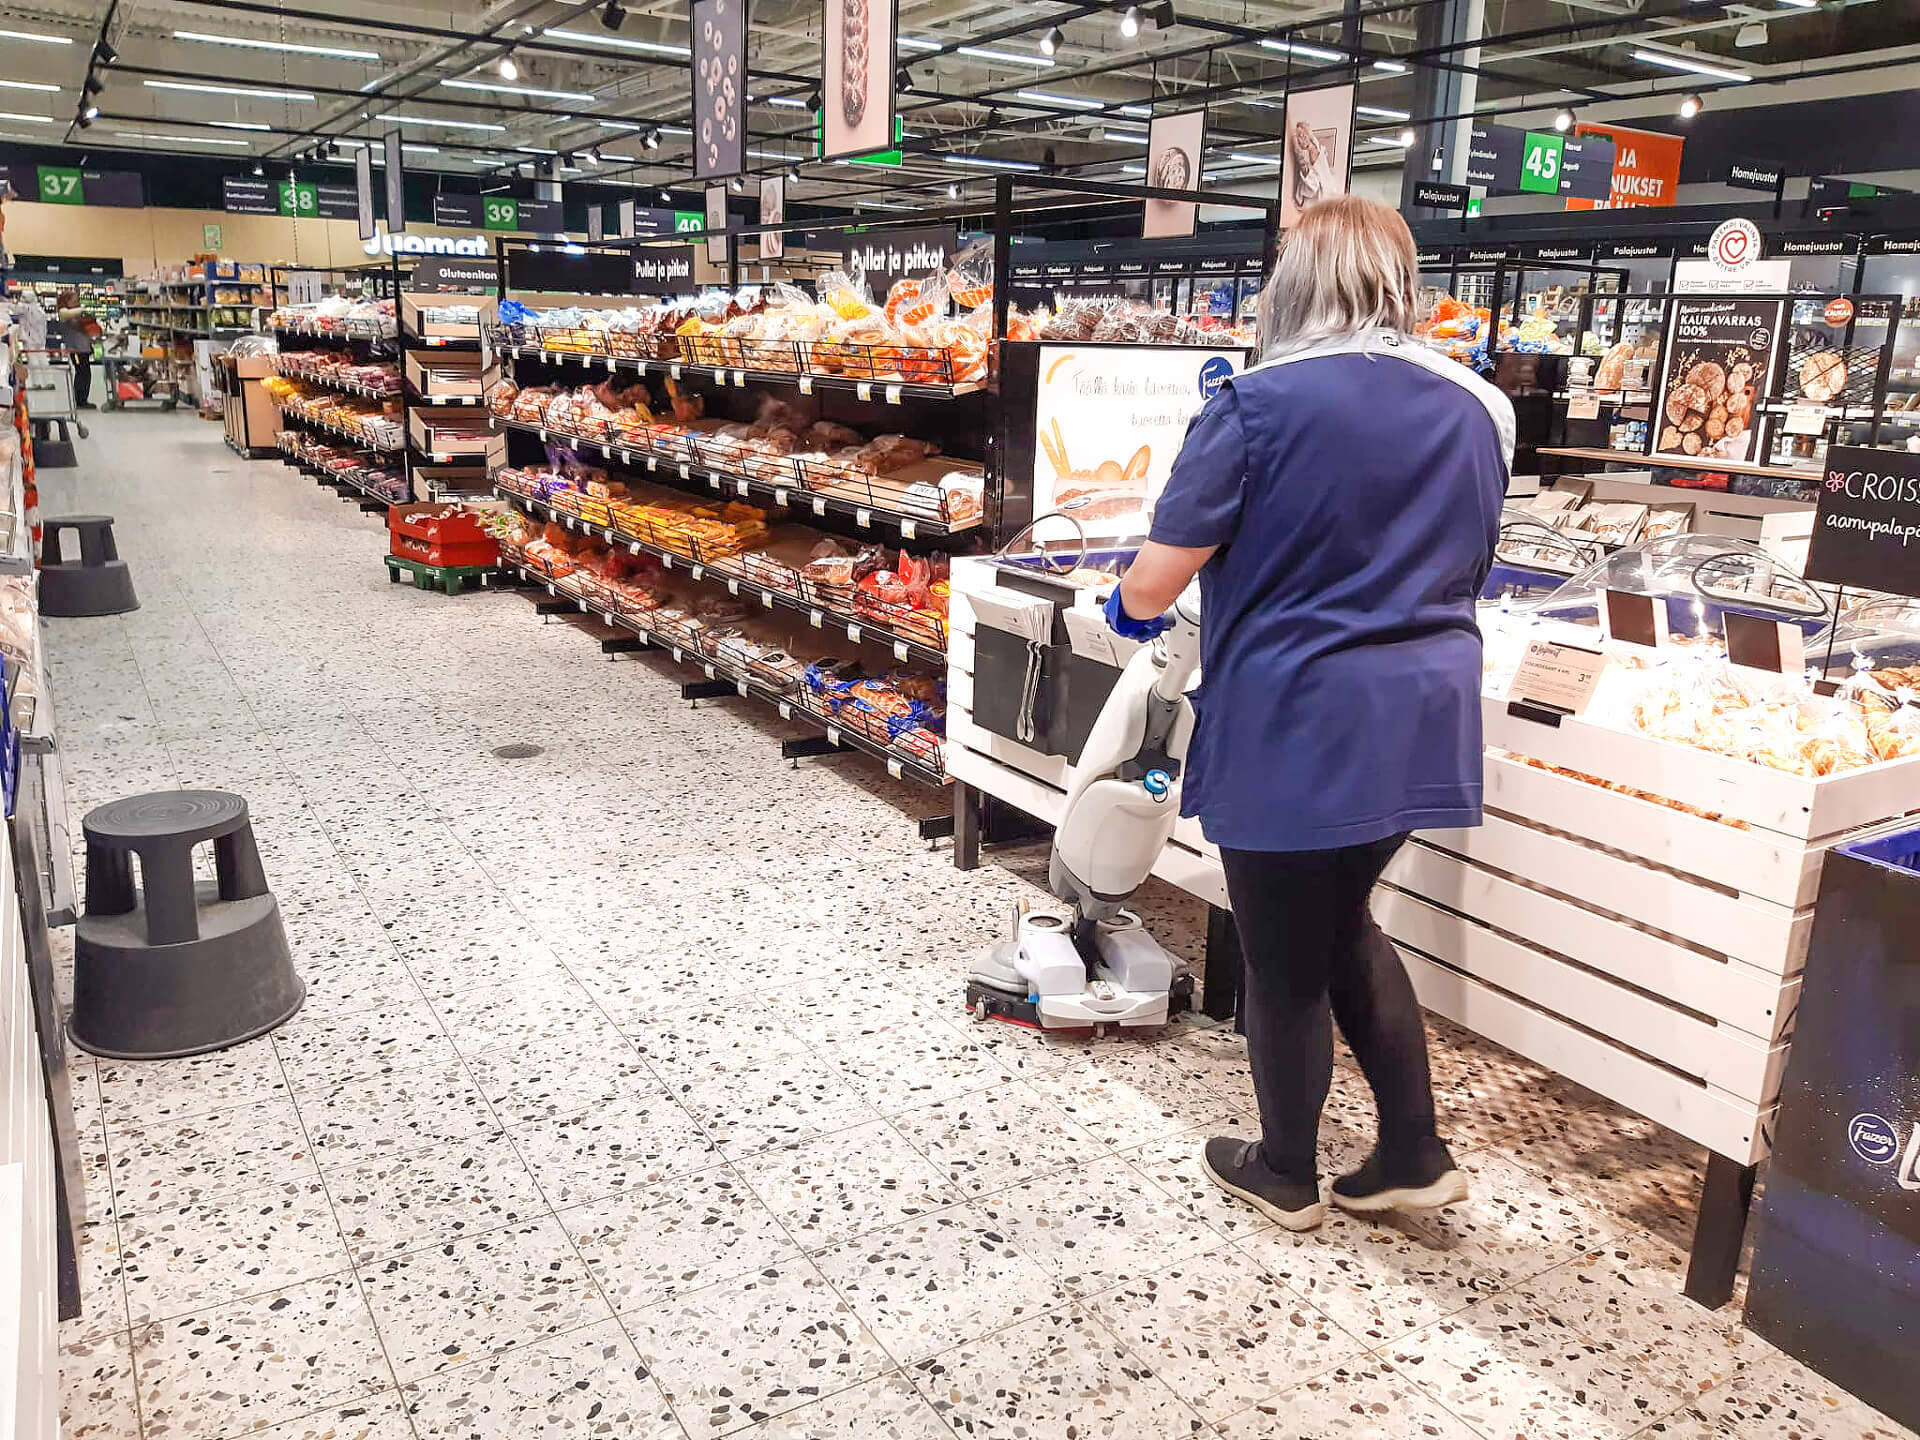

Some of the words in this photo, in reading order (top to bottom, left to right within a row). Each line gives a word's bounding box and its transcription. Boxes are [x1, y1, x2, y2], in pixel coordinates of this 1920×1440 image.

[1526, 146, 1557, 179] 45
[1618, 147, 1637, 169] JA
[1731, 165, 1778, 184] Homejuustot
[44, 174, 78, 196] 37
[283, 189, 313, 210] 38
[1419, 189, 1460, 203] Palajuustot
[487, 204, 515, 222] 39
[677, 218, 702, 233] 40
[363, 227, 488, 256] Juomat
[1784, 242, 1843, 253] Homejuustot
[851, 247, 886, 272] Pullat
[888, 247, 902, 276] ja
[904, 244, 945, 275] pitkot
[1469, 251, 1506, 261] Palajuustot
[1538, 249, 1579, 259] Palajuustot
[1613, 246, 1658, 257] Palajuustot
[635, 261, 657, 278] Pullat
[657, 260, 666, 282] ja
[667, 259, 689, 282] pitkot
[1680, 315, 1762, 327] KAURAVARRAS
[1678, 326, 1708, 337] 100%
[1854, 1122, 1895, 1146] Fazer
